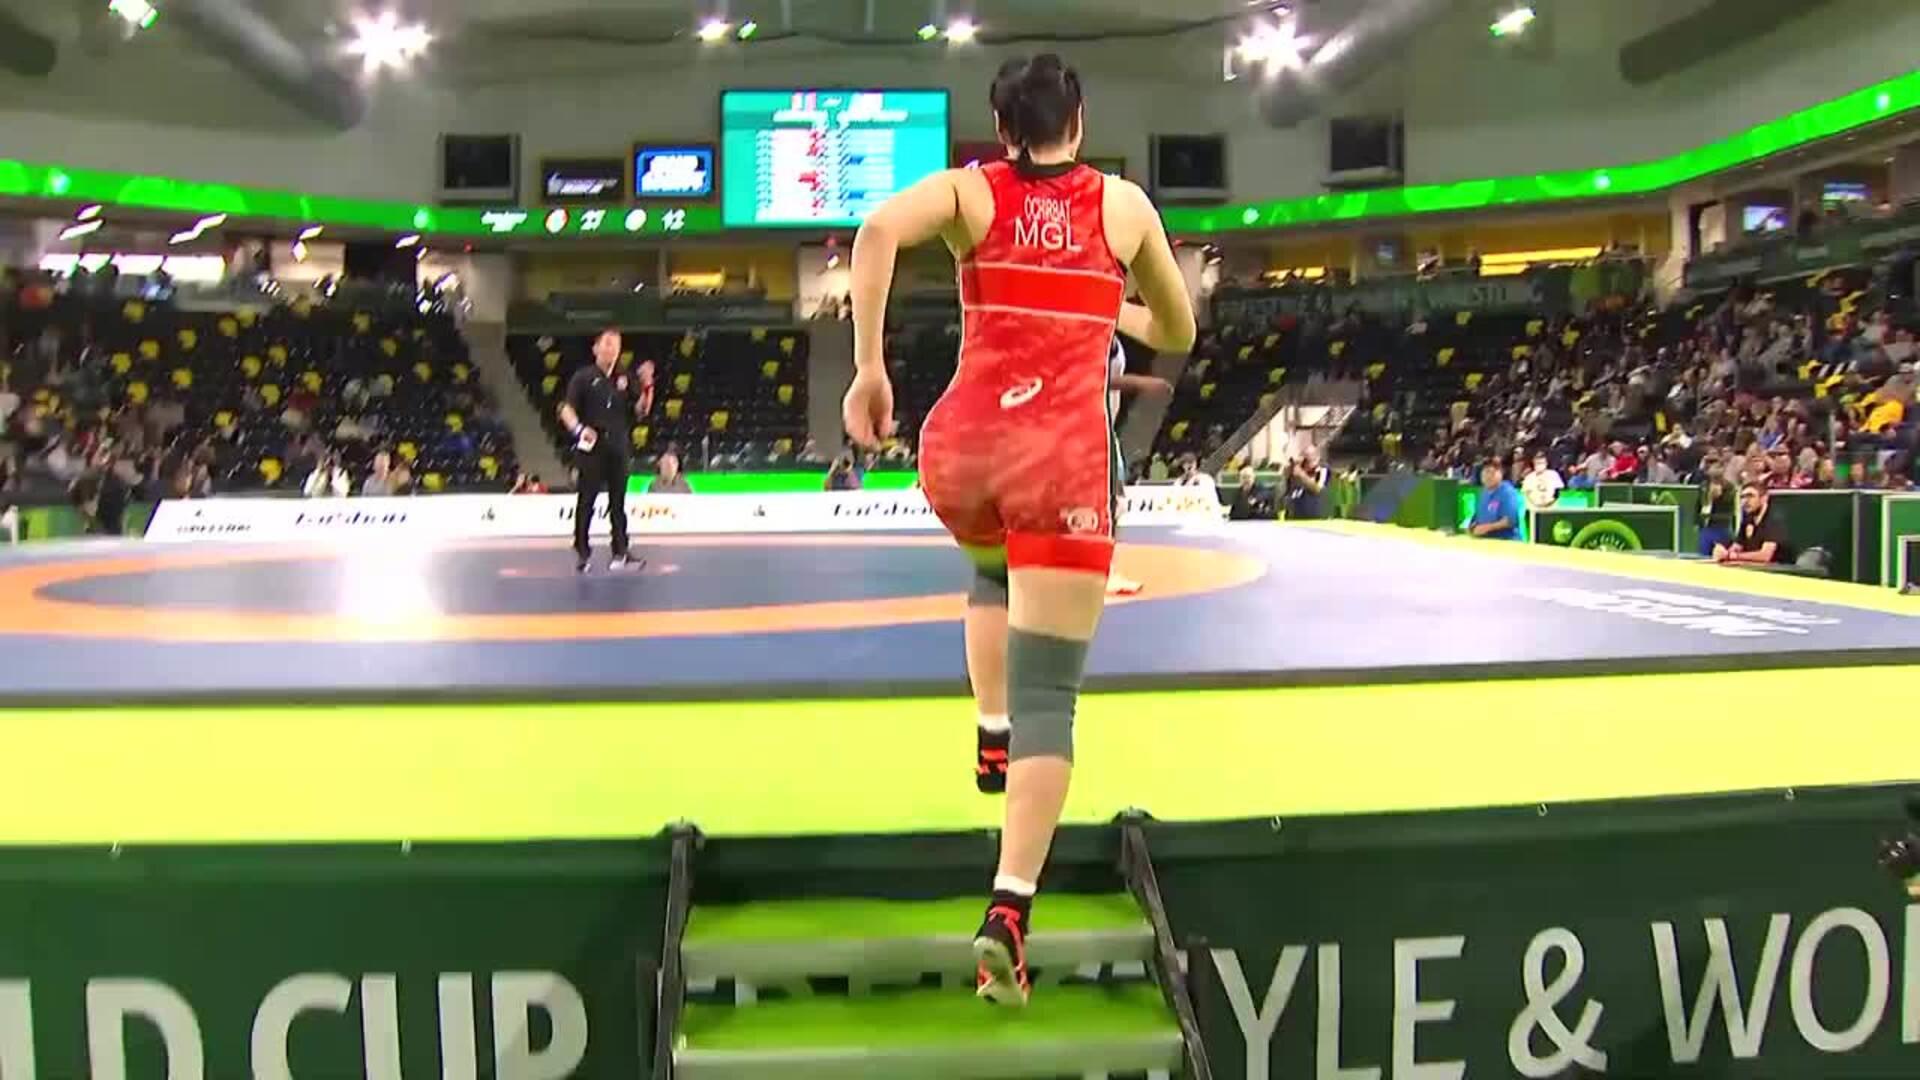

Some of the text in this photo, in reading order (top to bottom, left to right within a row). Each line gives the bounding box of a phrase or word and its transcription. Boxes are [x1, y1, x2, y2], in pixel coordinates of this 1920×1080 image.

[661, 208, 686, 231] 12
[1014, 217, 1082, 252] MGL
[250, 970, 588, 1080] CUP
[1508, 926, 1608, 1079] &
[1651, 905, 1920, 1064] WO
